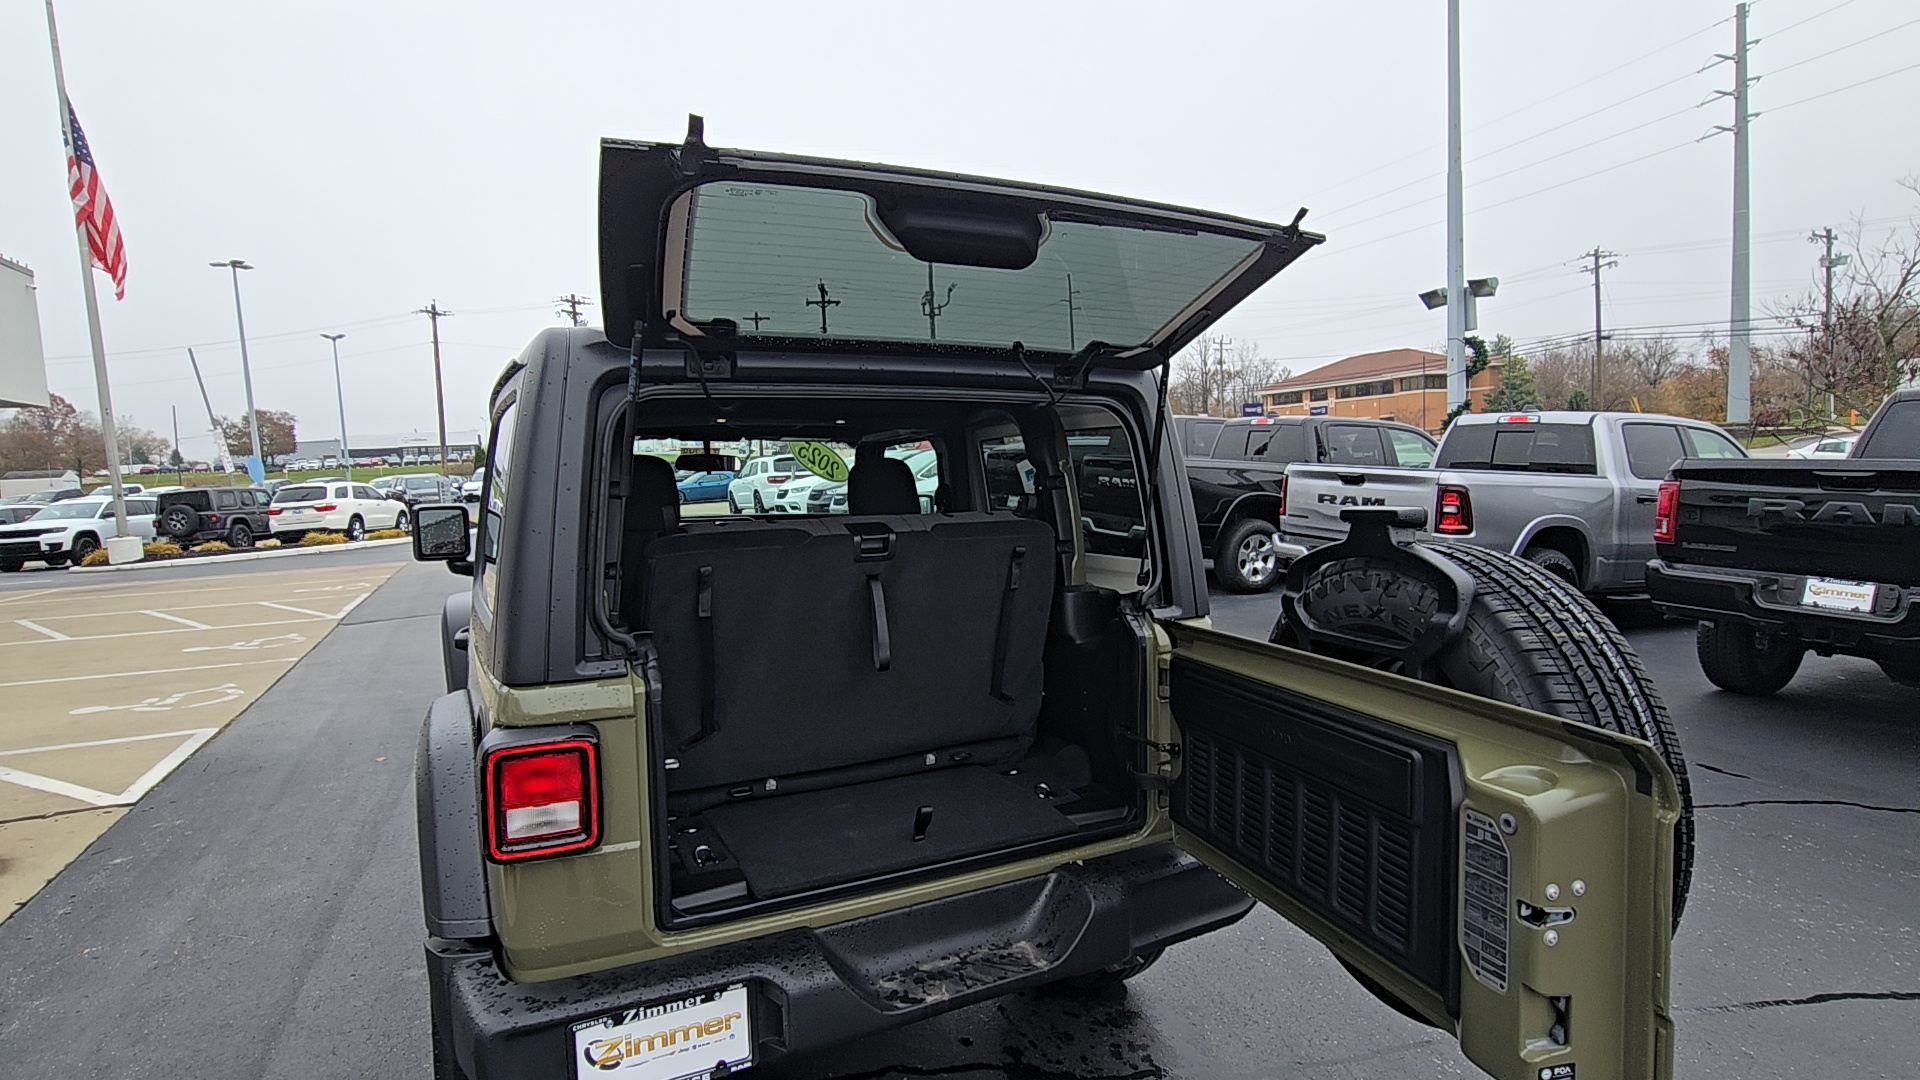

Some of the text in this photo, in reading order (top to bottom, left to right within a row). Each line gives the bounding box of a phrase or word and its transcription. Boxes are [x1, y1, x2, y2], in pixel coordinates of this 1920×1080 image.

[1098, 476, 1135, 488] RAM
[1318, 493, 1385, 506] RAM
[1812, 585, 1870, 599] Zimmer
[622, 993, 706, 1025] Zimmer
[594, 1011, 742, 1066] Zimmer
